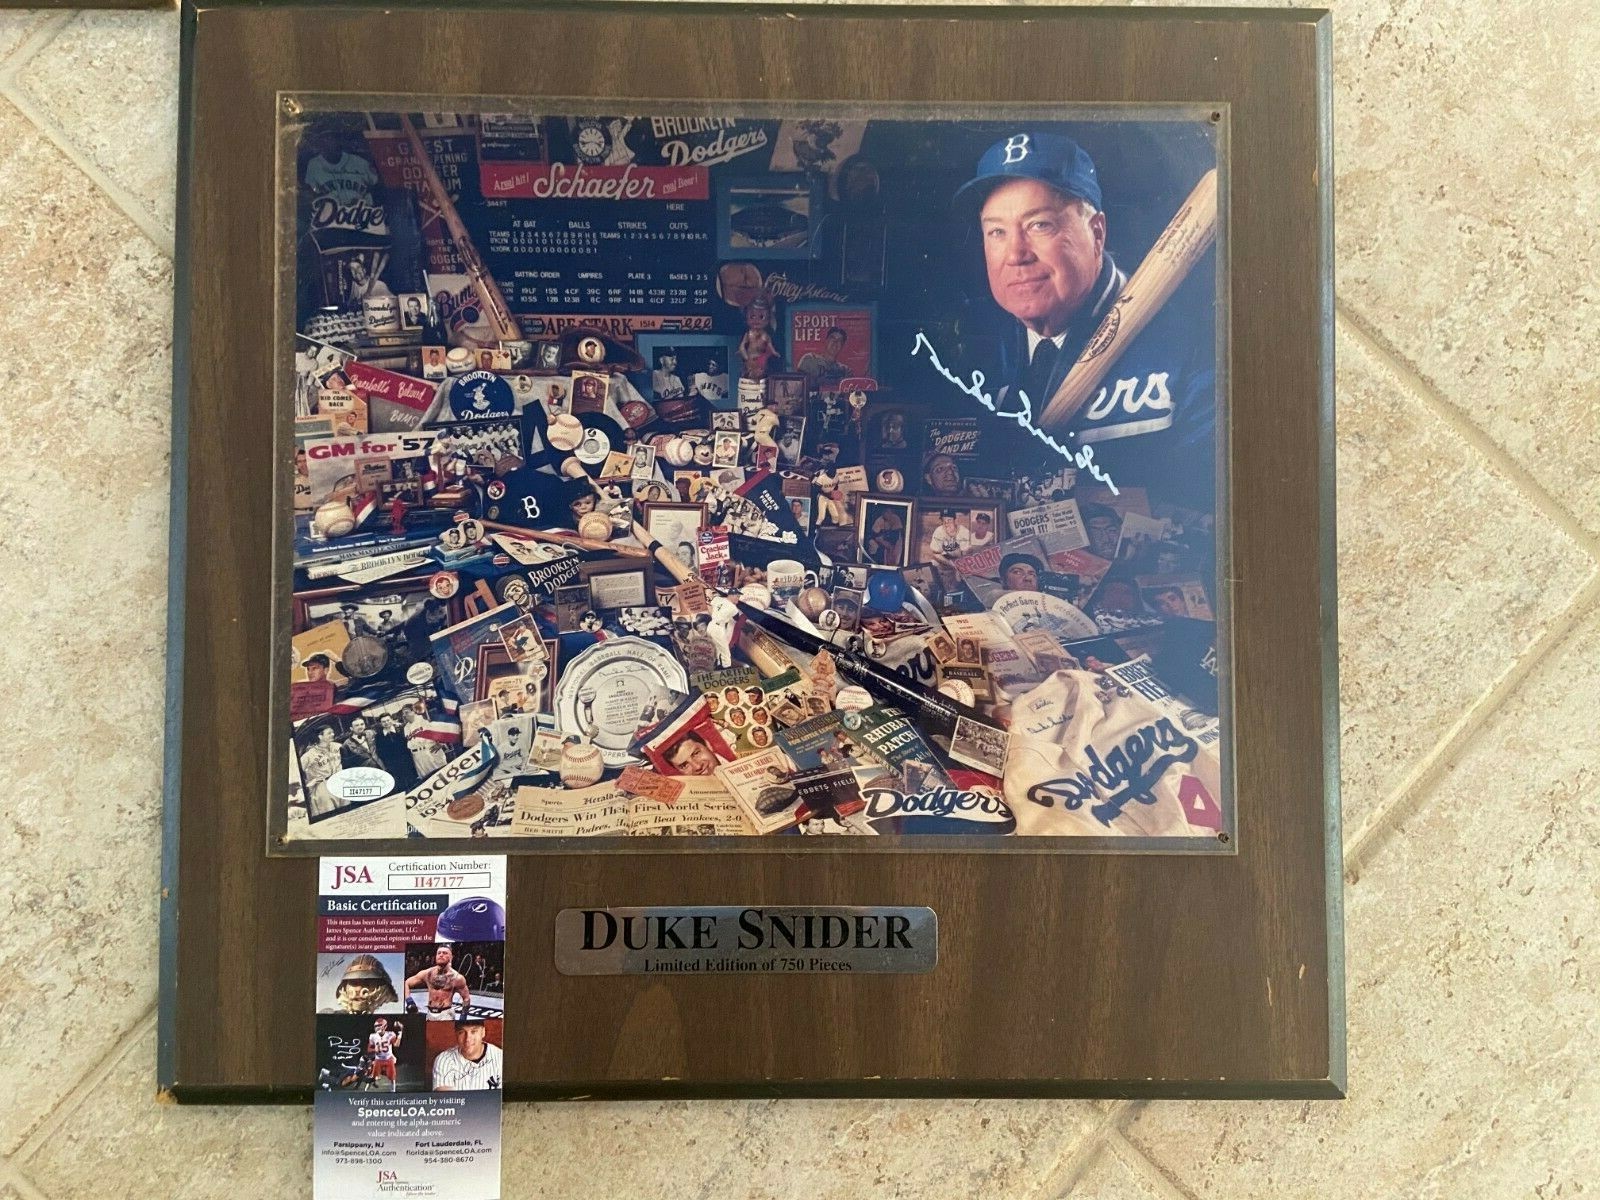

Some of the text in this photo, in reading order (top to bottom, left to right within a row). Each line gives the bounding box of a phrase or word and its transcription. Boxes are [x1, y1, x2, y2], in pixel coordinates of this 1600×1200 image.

[661, 128, 767, 167] Dodgers
[1003, 133, 1030, 165] B
[533, 162, 655, 200] Schaefer
[666, 203, 685, 211] HERE
[513, 220, 521, 228] AT
[568, 221, 590, 229] BALLS
[669, 222, 689, 230] OUTS
[540, 271, 560, 279] ORDER
[794, 315, 838, 329] SPORT
[794, 328, 821, 342] LIFE
[458, 370, 497, 387] BROOKLYN
[935, 430, 979, 447] DODGERS
[308, 442, 356, 459] GM
[361, 440, 398, 454] for
[521, 496, 541, 519] B
[1014, 513, 1050, 529] DODGERS
[700, 543, 728, 553] Cracker
[527, 557, 580, 588] BROOKLYN
[704, 677, 751, 690] DODGERS
[860, 786, 1014, 820] Dodgers
[521, 802, 737, 824] Dodgers Win Their First World Series
[388, 861, 491, 872] Certification Number:
[331, 865, 374, 889] JSA
[414, 876, 464, 888] II47177
[327, 899, 438, 911] Basic Certification
[417, 918, 424, 926] by
[580, 908, 914, 952] DUKE SNIDER
[644, 957, 853, 973] Limited Edition of 750 Pieces
[375, 1041, 389, 1053] 15
[349, 1096, 466, 1107] Verify this certification by visiting
[357, 1106, 456, 1119] SpenceLOA.com
[352, 1118, 462, 1128] and entering the alpha-numeric
[367, 1128, 445, 1137] value indicated above.
[431, 1140, 473, 1148] Lauderdale,
[376, 1170, 398, 1184] JSA
[376, 1183, 433, 1192] Authentication
